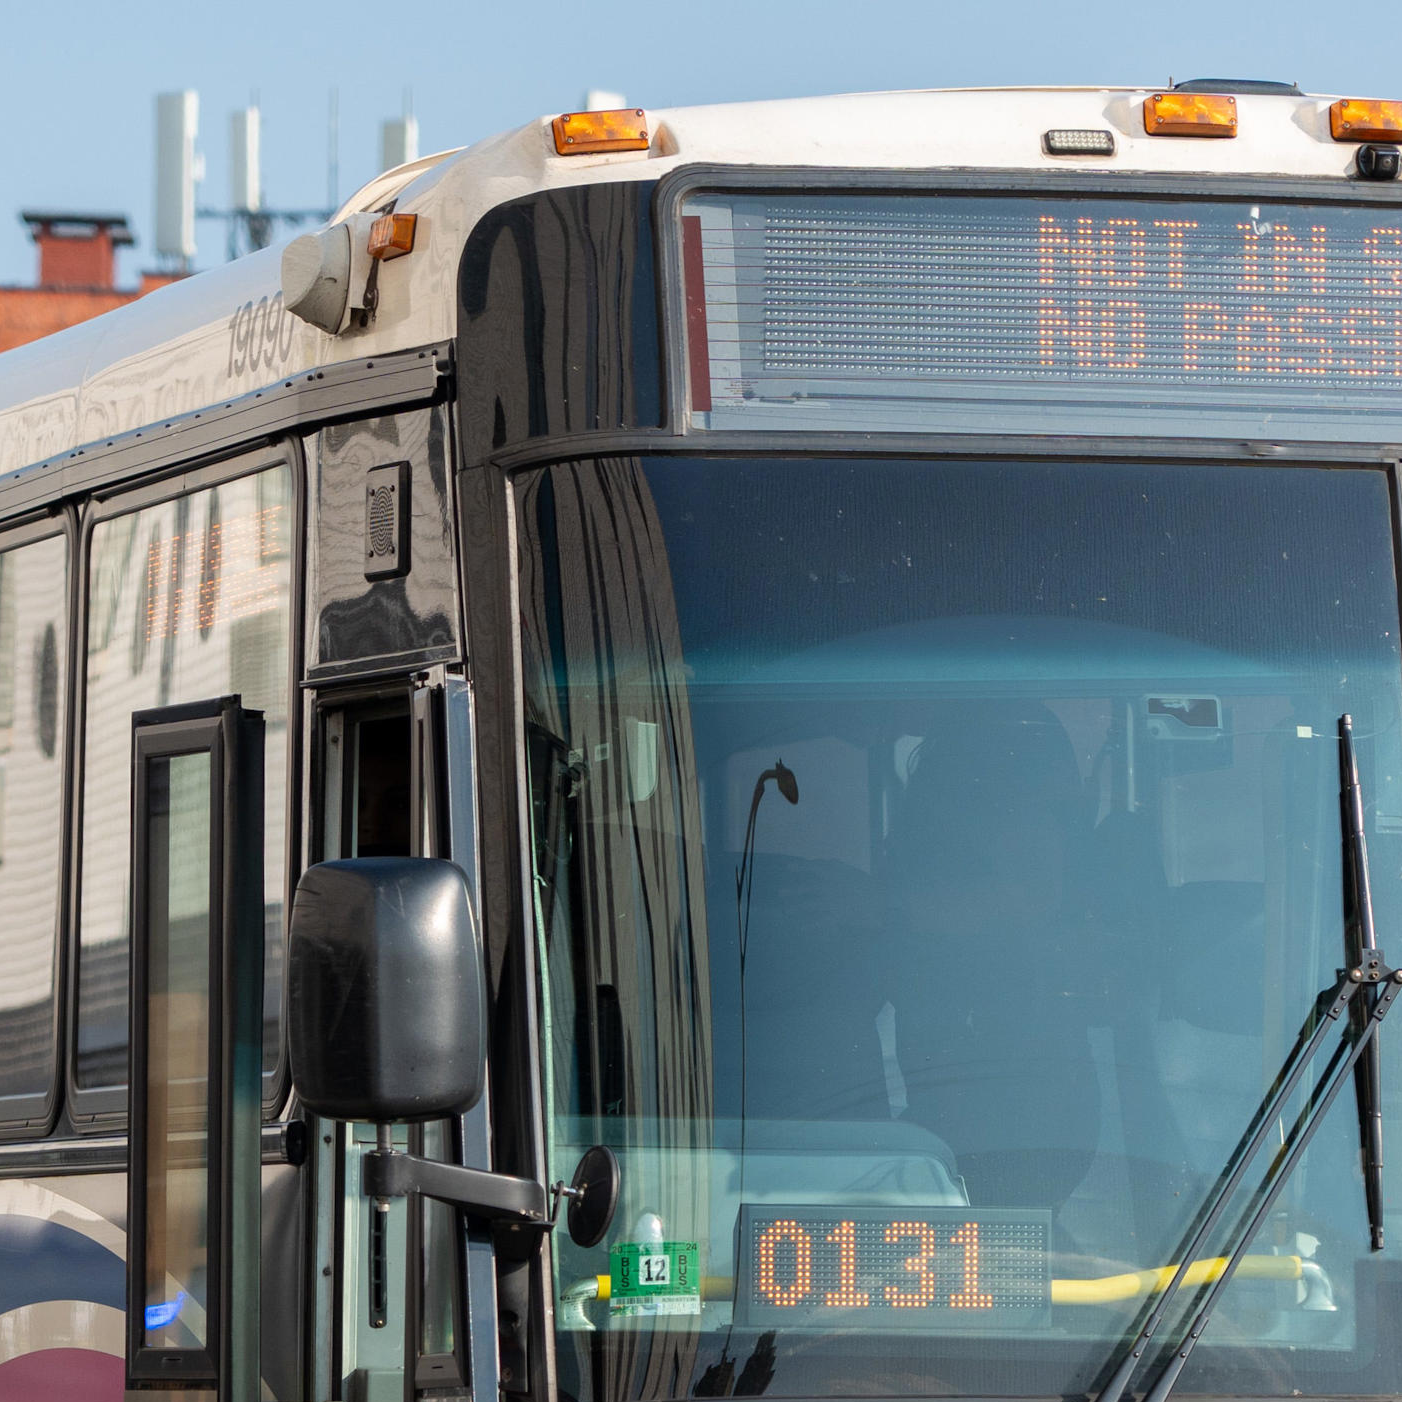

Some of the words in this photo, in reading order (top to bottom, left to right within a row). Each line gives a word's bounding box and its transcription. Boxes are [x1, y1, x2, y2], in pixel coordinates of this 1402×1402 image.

[1038, 214, 1200, 288] NOT
[1235, 222, 1327, 296] IN
[228, 291, 294, 378] 19090
[1038, 297, 1146, 369] NO
[621, 1256, 630, 1288] BUS
[644, 1258, 666, 1282] 12
[678, 1254, 688, 1286] BUS
[685, 1243, 697, 1251] 24
[759, 1219, 993, 1309] 0131
